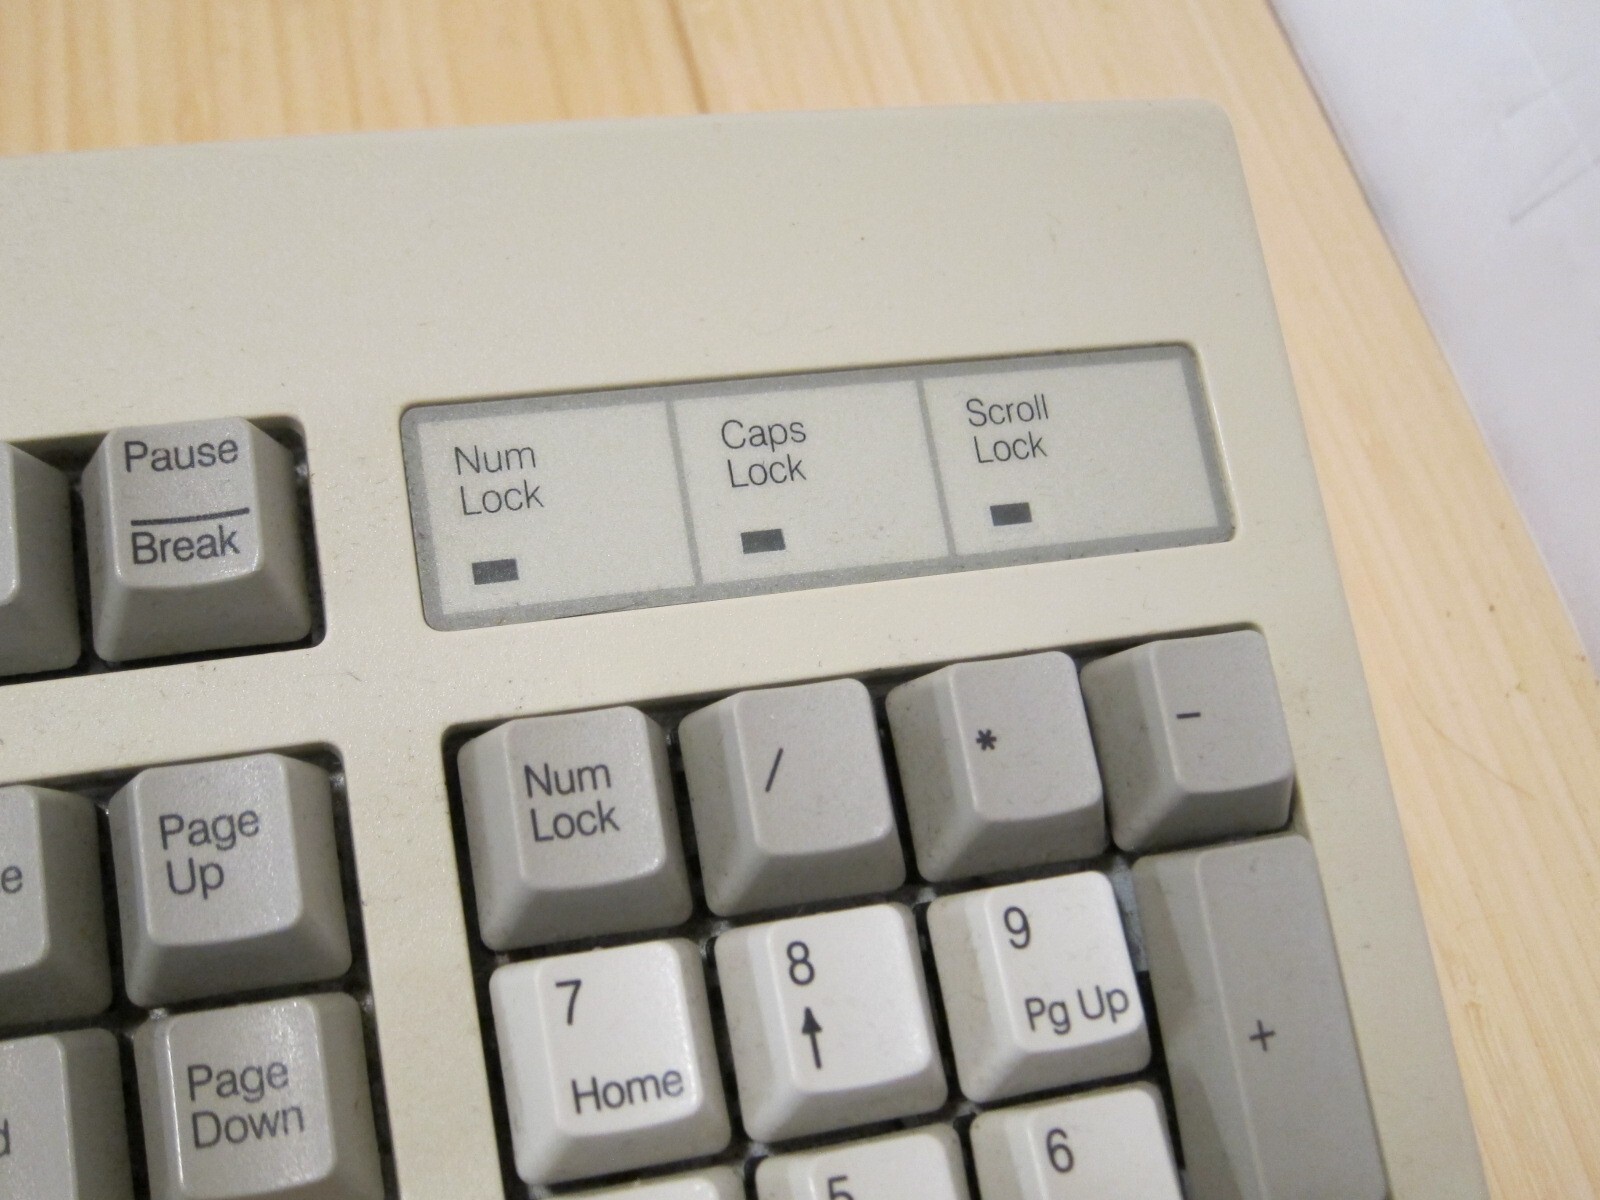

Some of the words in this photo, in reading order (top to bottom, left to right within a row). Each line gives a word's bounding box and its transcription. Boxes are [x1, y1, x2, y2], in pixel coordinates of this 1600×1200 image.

[966, 393, 1049, 427] Scroll
[123, 438, 238, 473] Pause
[721, 419, 807, 453] Caps
[973, 430, 1048, 464] Lock
[454, 444, 536, 476] Num
[727, 453, 807, 488] Lock
[460, 478, 544, 516] Lock
[130, 524, 240, 565] Break
[523, 762, 612, 799] Num
[158, 810, 259, 851] Page
[529, 800, 620, 843] Lock
[166, 858, 225, 900] Up
[1003, 906, 1031, 951] 9
[786, 940, 815, 986] 8
[555, 979, 582, 1026] 7
[1024, 997, 1071, 1036] Pg
[1076, 984, 1130, 1023] Up
[186, 1063, 288, 1103] Page
[571, 1070, 684, 1115] Home
[191, 1105, 304, 1150] Down
[1046, 1128, 1074, 1174] 6
